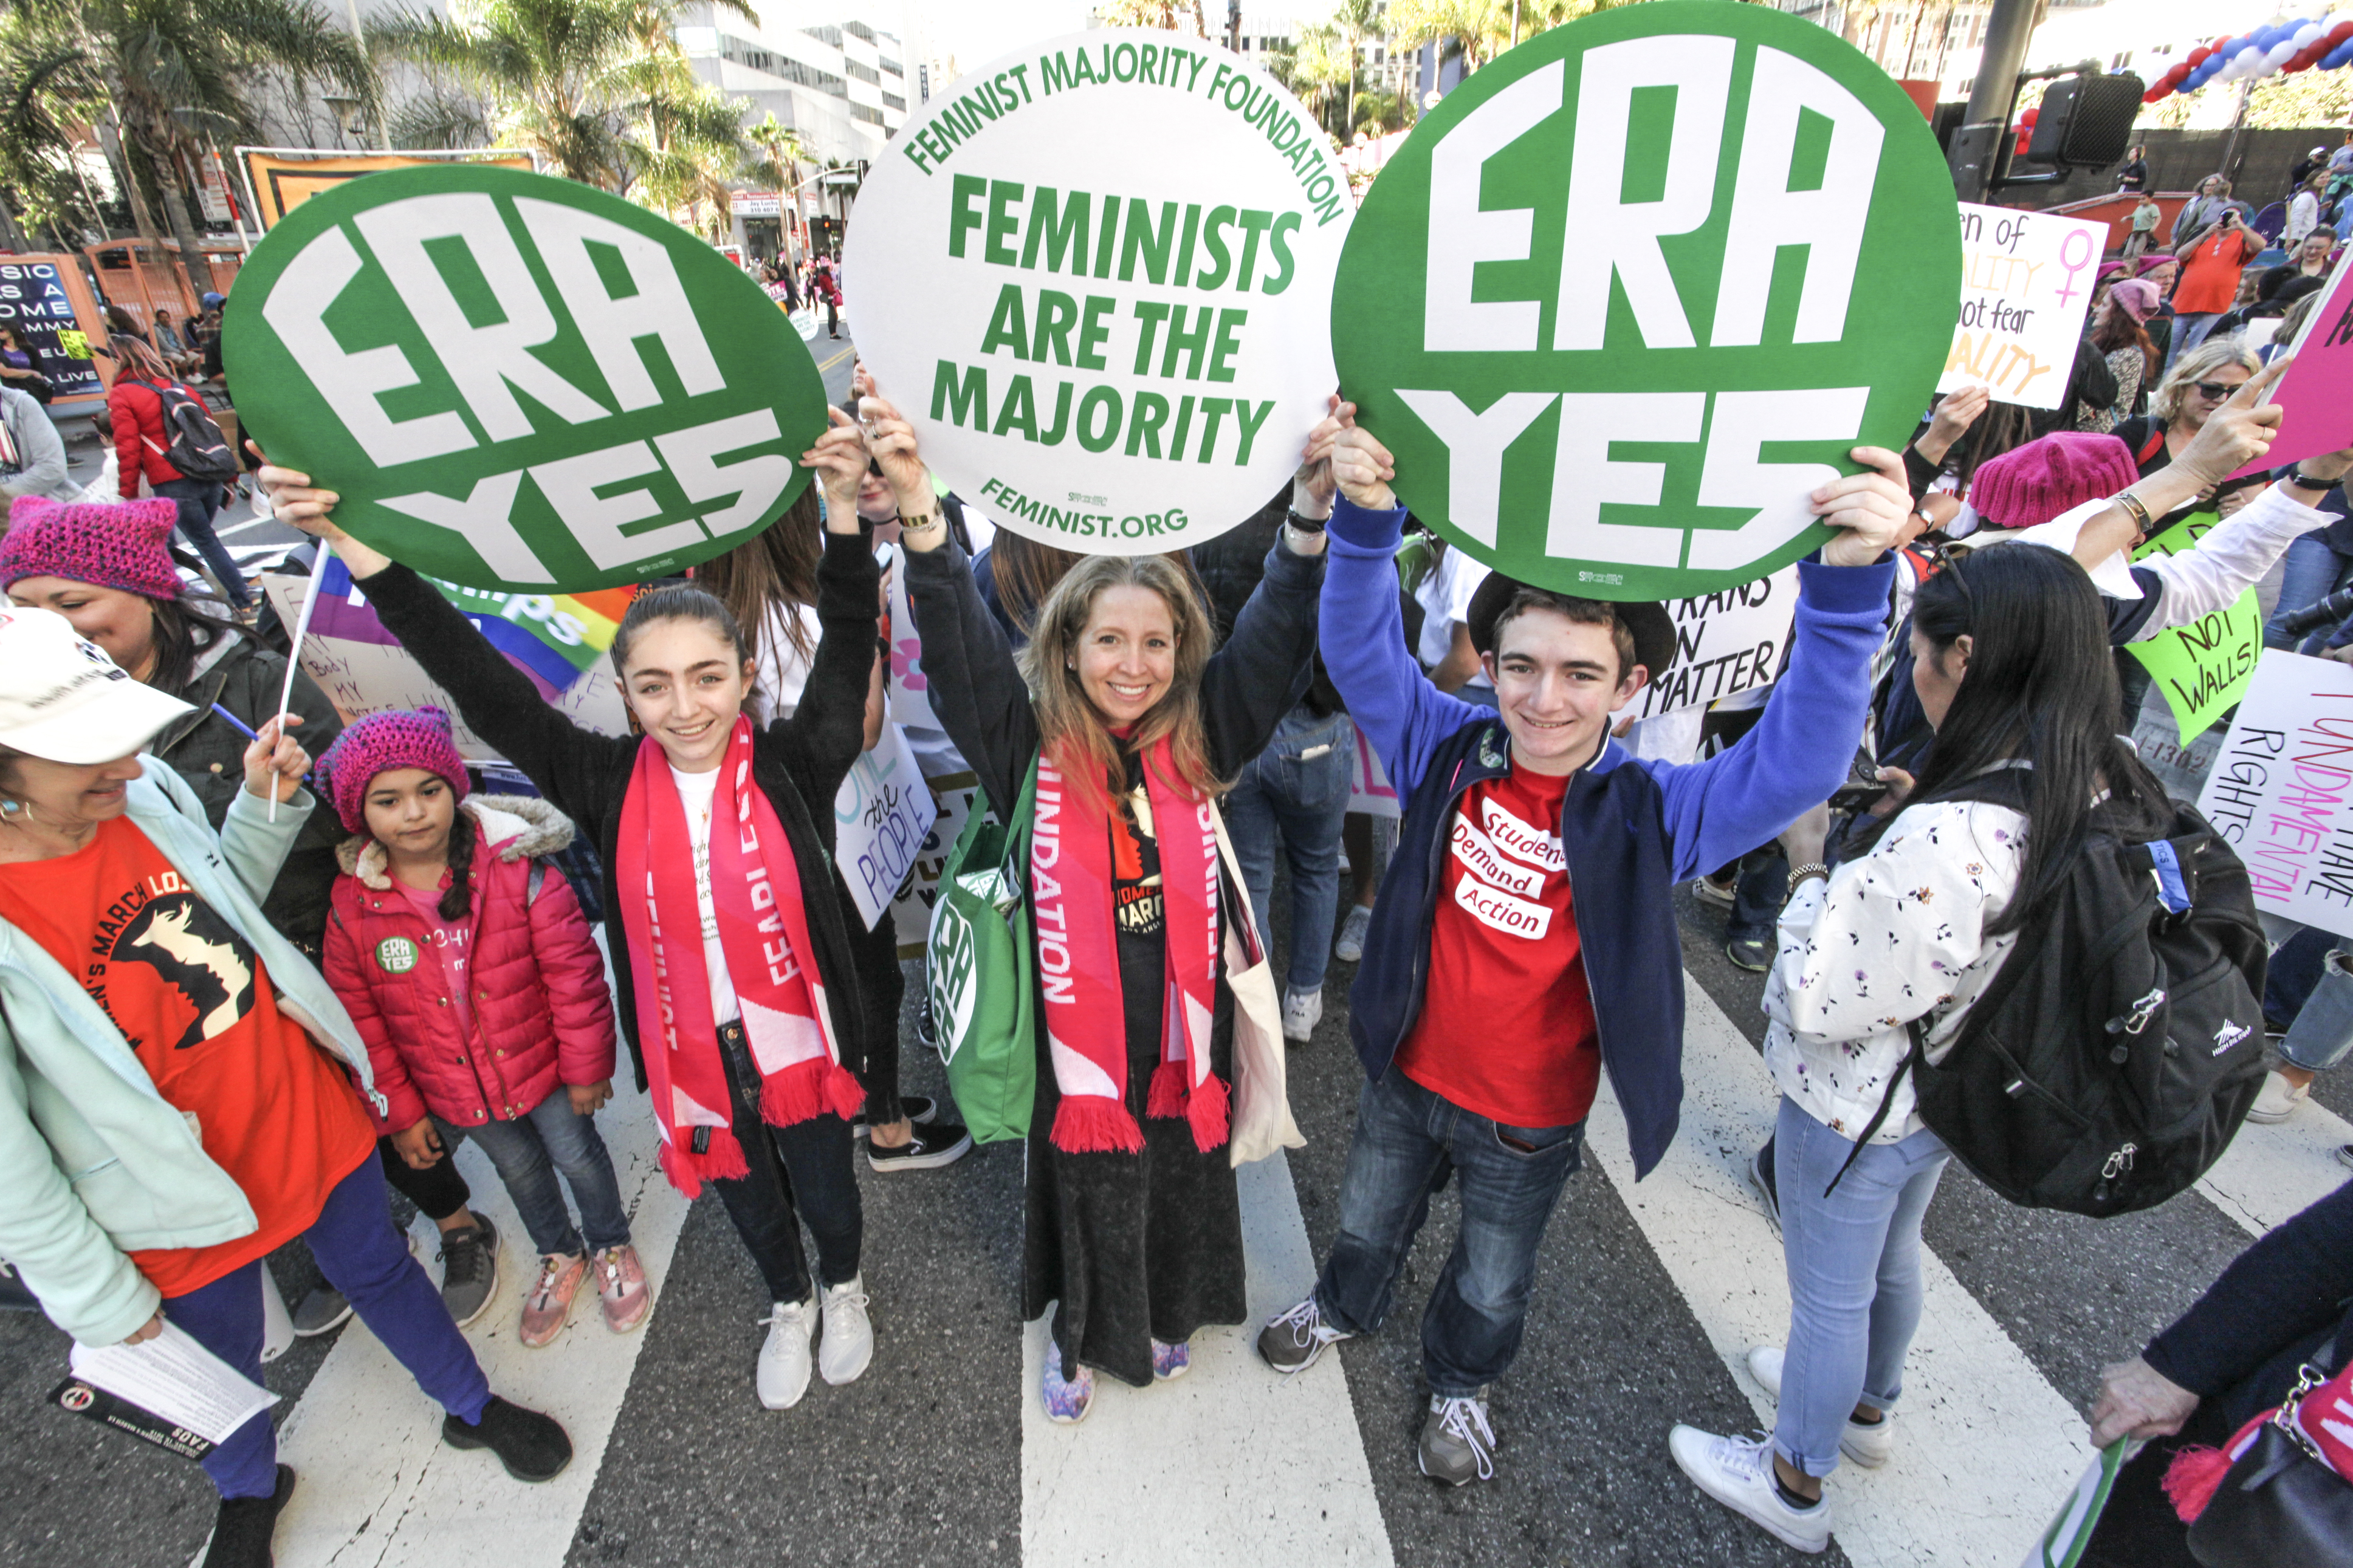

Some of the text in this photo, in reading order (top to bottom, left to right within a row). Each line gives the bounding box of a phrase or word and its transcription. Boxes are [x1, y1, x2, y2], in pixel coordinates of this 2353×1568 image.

[903, 42, 1344, 228] FEMINIST MAJORITY FOUNDATION
[1424, 34, 1886, 352] ERA
[949, 173, 1302, 296] FEMINISTS
[1996, 214, 2030, 255] of
[21, 320, 75, 333] MMY
[263, 193, 727, 469] ERA
[981, 284, 1248, 383] ARE THE
[1991, 299, 2035, 334] fear
[57, 370, 98, 383] LIVE
[1943, 332, 2051, 397] ALITY
[929, 359, 1276, 467] MAJORITY
[374, 407, 792, 584] YES
[980, 478, 1189, 538] FEMINIST.ORG
[1393, 386, 1870, 570] YES
[335, 680, 363, 703] MY
[1642, 640, 1774, 719] MATTER
[2171, 614, 2259, 714] WALLS!
[865, 784, 898, 830] the
[857, 784, 929, 910] PEOPLE
[1452, 823, 1533, 891] Demand
[92, 882, 148, 956] MARCH
[1462, 889, 1539, 932] Action
[381, 938, 410, 957] ERA
[381, 956, 413, 971] YES
